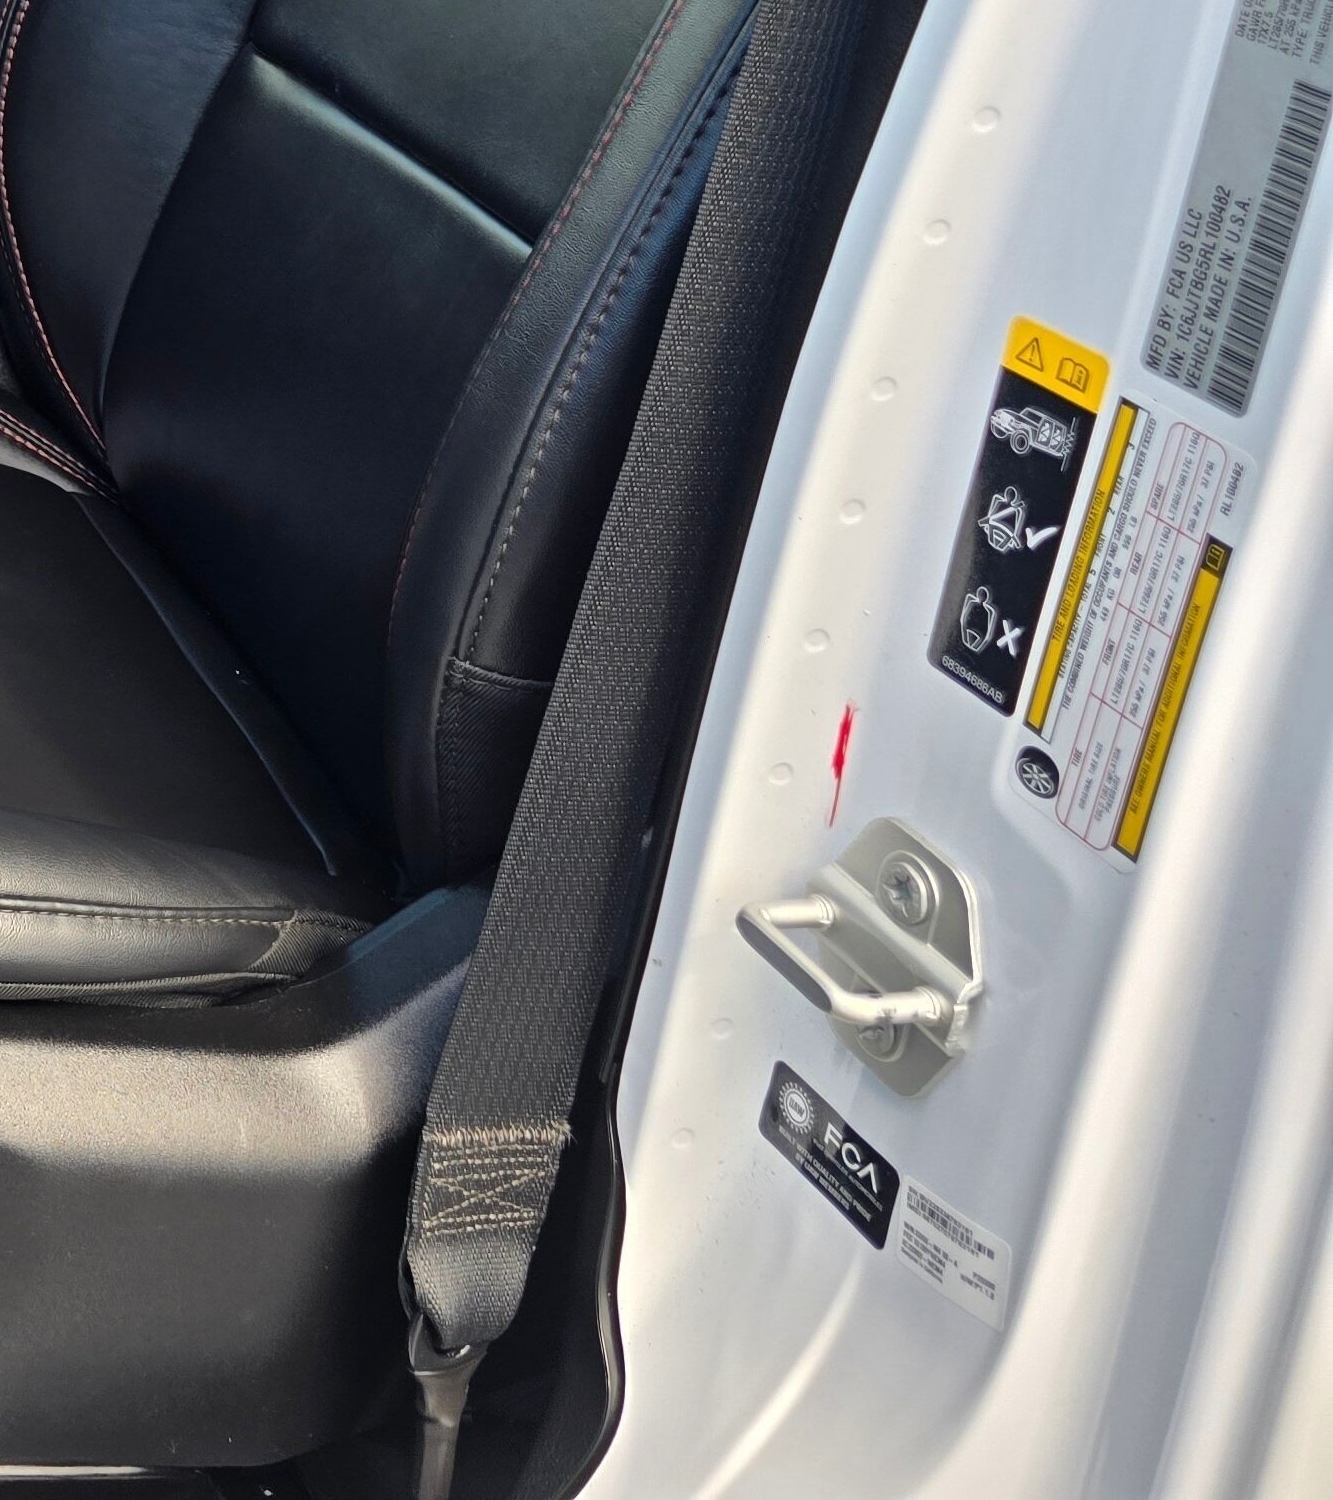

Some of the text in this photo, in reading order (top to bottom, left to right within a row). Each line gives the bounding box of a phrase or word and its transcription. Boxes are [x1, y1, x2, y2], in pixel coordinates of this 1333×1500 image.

[1234, 8, 1250, 38] DATE
[1245, 8, 1262, 42] GAWR
[1283, 17, 1297, 38] 255
[1279, 38, 1291, 55] AT
[1309, 39, 1324, 66] THIS
[1145, 206, 1203, 370] MFD BY: FCA US LLC
[1183, 191, 1251, 391] VEHICLE MADE IN: U.S.A.
[1163, 345, 1186, 381] VIN:
[1141, 416, 1157, 450] EXCEED
[1132, 449, 1146, 478] NEVER
[1122, 478, 1137, 512] SHOULD
[1219, 459, 1244, 517] RL100482
[1107, 505, 1115, 515] 2
[1113, 511, 1127, 542] CARGO
[1051, 487, 1105, 643] TIRE AND LOADING INFORMATION
[1108, 541, 1118, 560] AND
[1093, 559, 1113, 608] OCCUPANTS
[1071, 481, 1164, 768] TIRE FRONT REAR SPARE
[1089, 607, 1098, 620] OF
[941, 655, 1004, 703] 68394686AB
[1066, 651, 1084, 694] COMBINED
[1061, 694, 1071, 710] THE
[1128, 794, 1141, 815] SEE
[1144, 728, 1161, 763] MANUAL
[1155, 707, 1167, 727] FOR
[1176, 601, 1200, 661] INFORMATION
[822, 1121, 883, 1194] FCA
